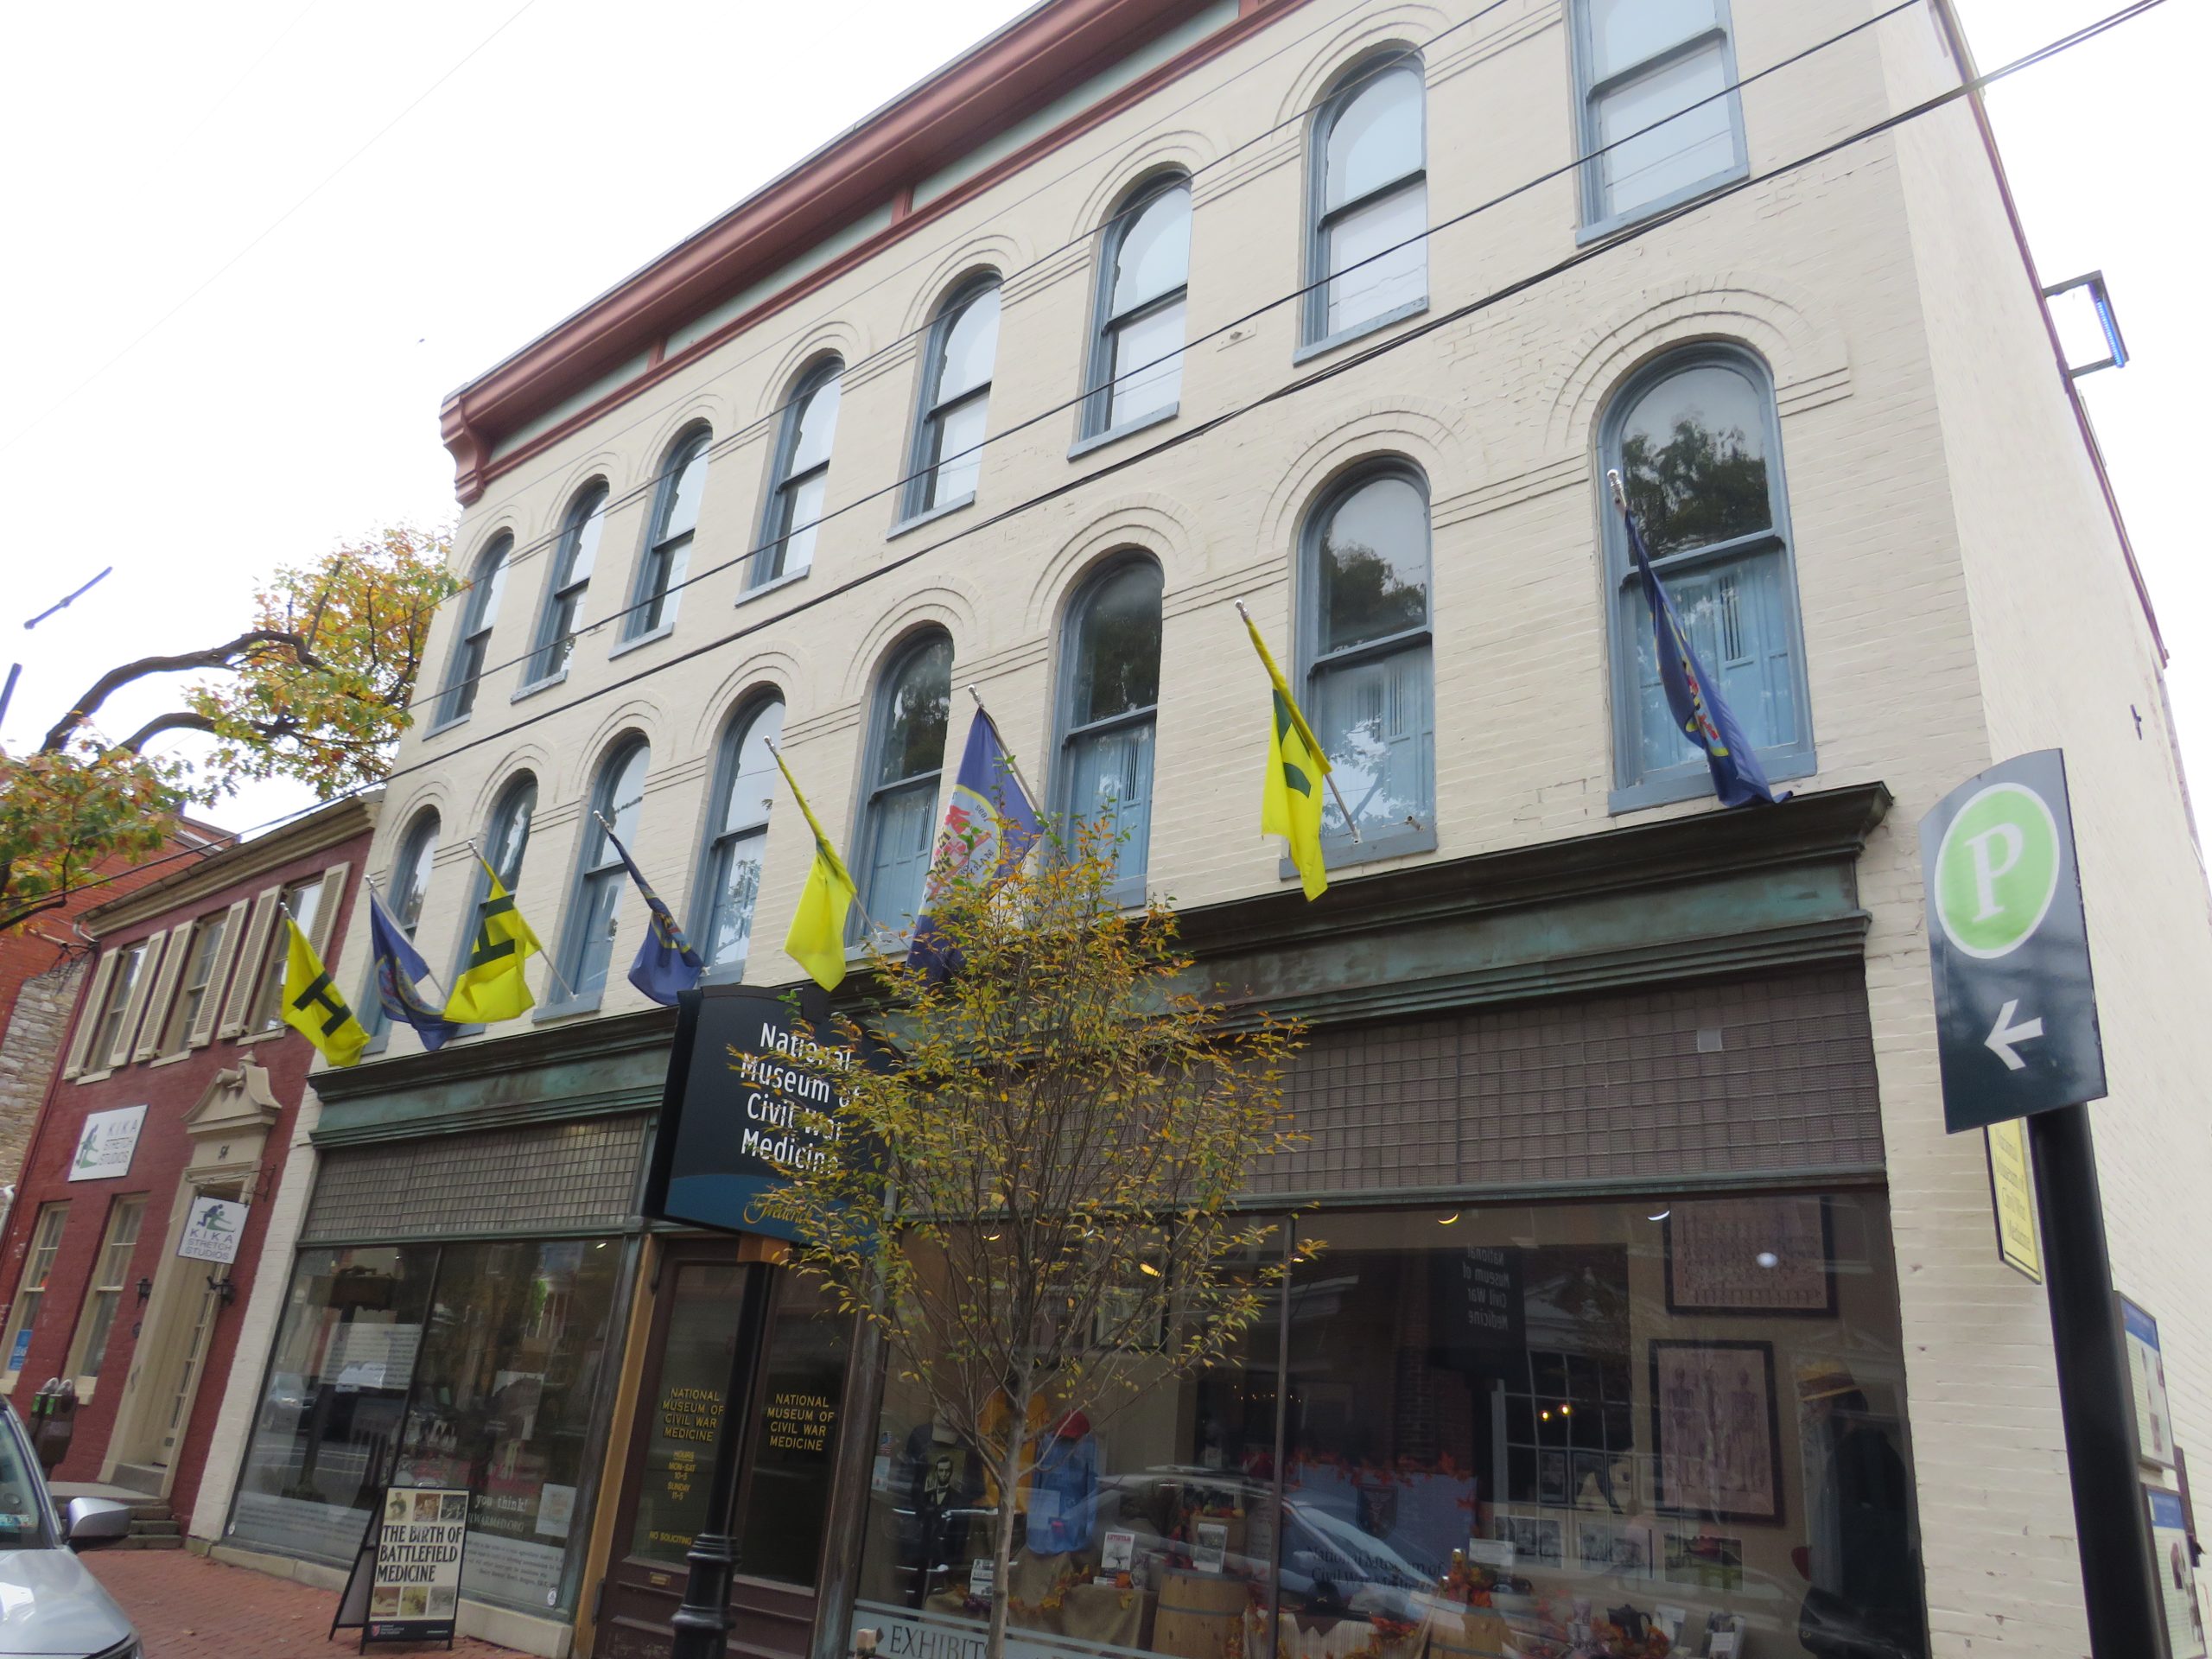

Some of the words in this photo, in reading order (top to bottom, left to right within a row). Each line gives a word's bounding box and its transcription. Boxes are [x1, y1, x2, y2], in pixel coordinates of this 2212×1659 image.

[1963, 823, 2024, 924] P
[741, 1056, 830, 1103] Museum
[747, 1092, 795, 1129] Civil
[190, 1228, 233, 1243] KIKA
[188, 1238, 232, 1251] STRETCH
[185, 1246, 230, 1261] STUDIOS
[671, 1388, 720, 1402] NATIONAL
[775, 1394, 830, 1408] NATIONAL
[662, 1401, 705, 1414] MUSEUM
[710, 1405, 725, 1415] OF
[766, 1407, 813, 1421] MUSEUM
[819, 1411, 834, 1423] OF
[664, 1414, 690, 1426] CIVIL
[695, 1417, 717, 1428] WAR
[664, 1427, 714, 1442] MEDICINE
[770, 1421, 798, 1434] CIVIL
[804, 1424, 827, 1437] WAR
[770, 1436, 823, 1451] MEDICINE
[667, 1481, 690, 1491] SUNDAY
[474, 1495, 493, 1509] you
[383, 1525, 405, 1542] THE
[410, 1526, 444, 1543] BIRTH
[448, 1526, 463, 1543] OF
[378, 1545, 458, 1563] BATTLEFIELD
[376, 1565, 435, 1583] MEDICINE
[890, 1625, 988, 1659] EXHIBIT
